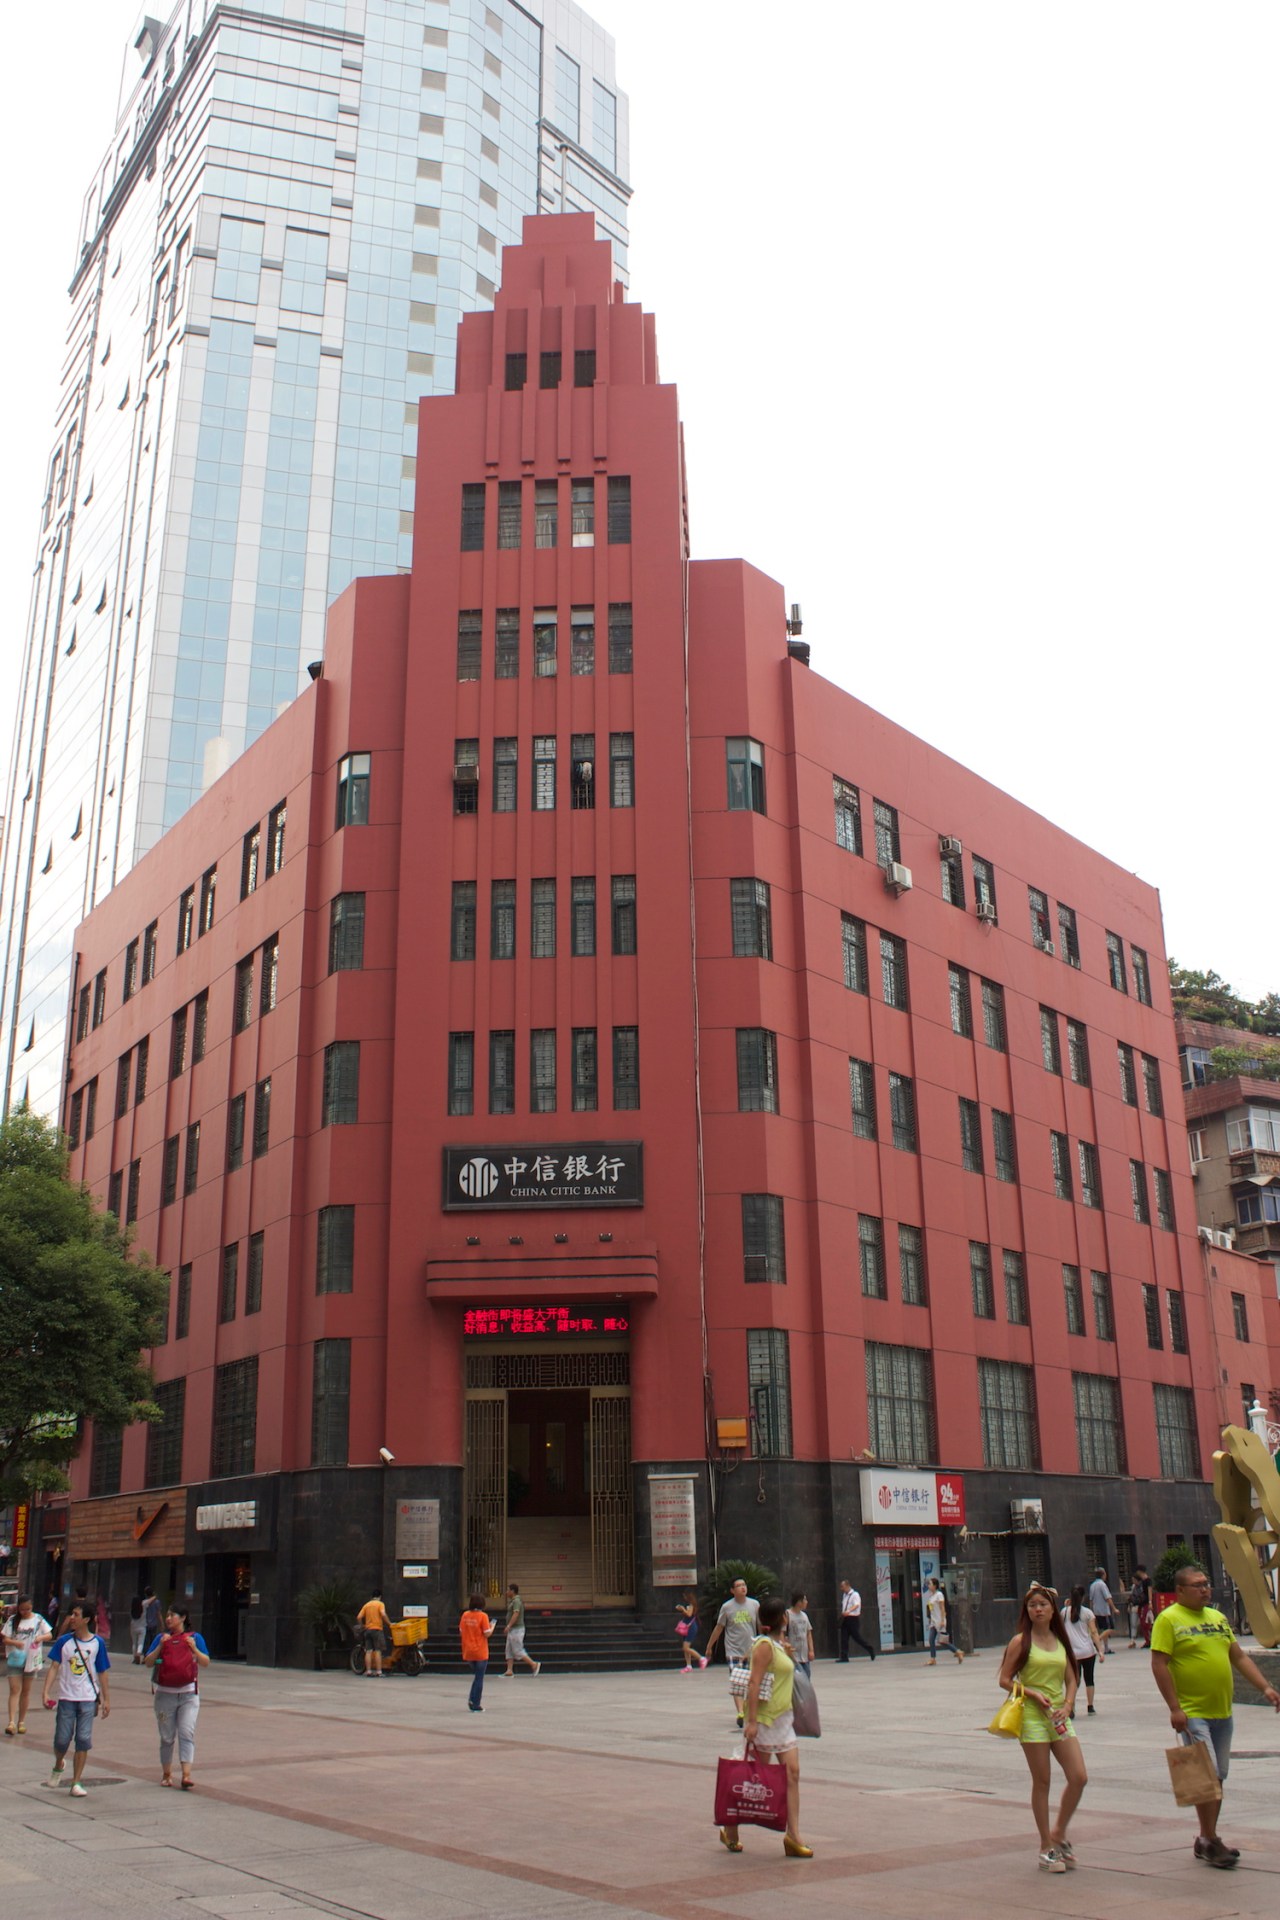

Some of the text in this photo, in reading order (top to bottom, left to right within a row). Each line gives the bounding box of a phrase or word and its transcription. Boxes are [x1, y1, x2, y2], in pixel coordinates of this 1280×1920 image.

[504, 1154, 626, 1186] 中信银行
[510, 1185, 616, 1197] CHINA CITIC BANK
[893, 1487, 929, 1504] 中信银行
[196, 1500, 256, 1531] CONVERSE
